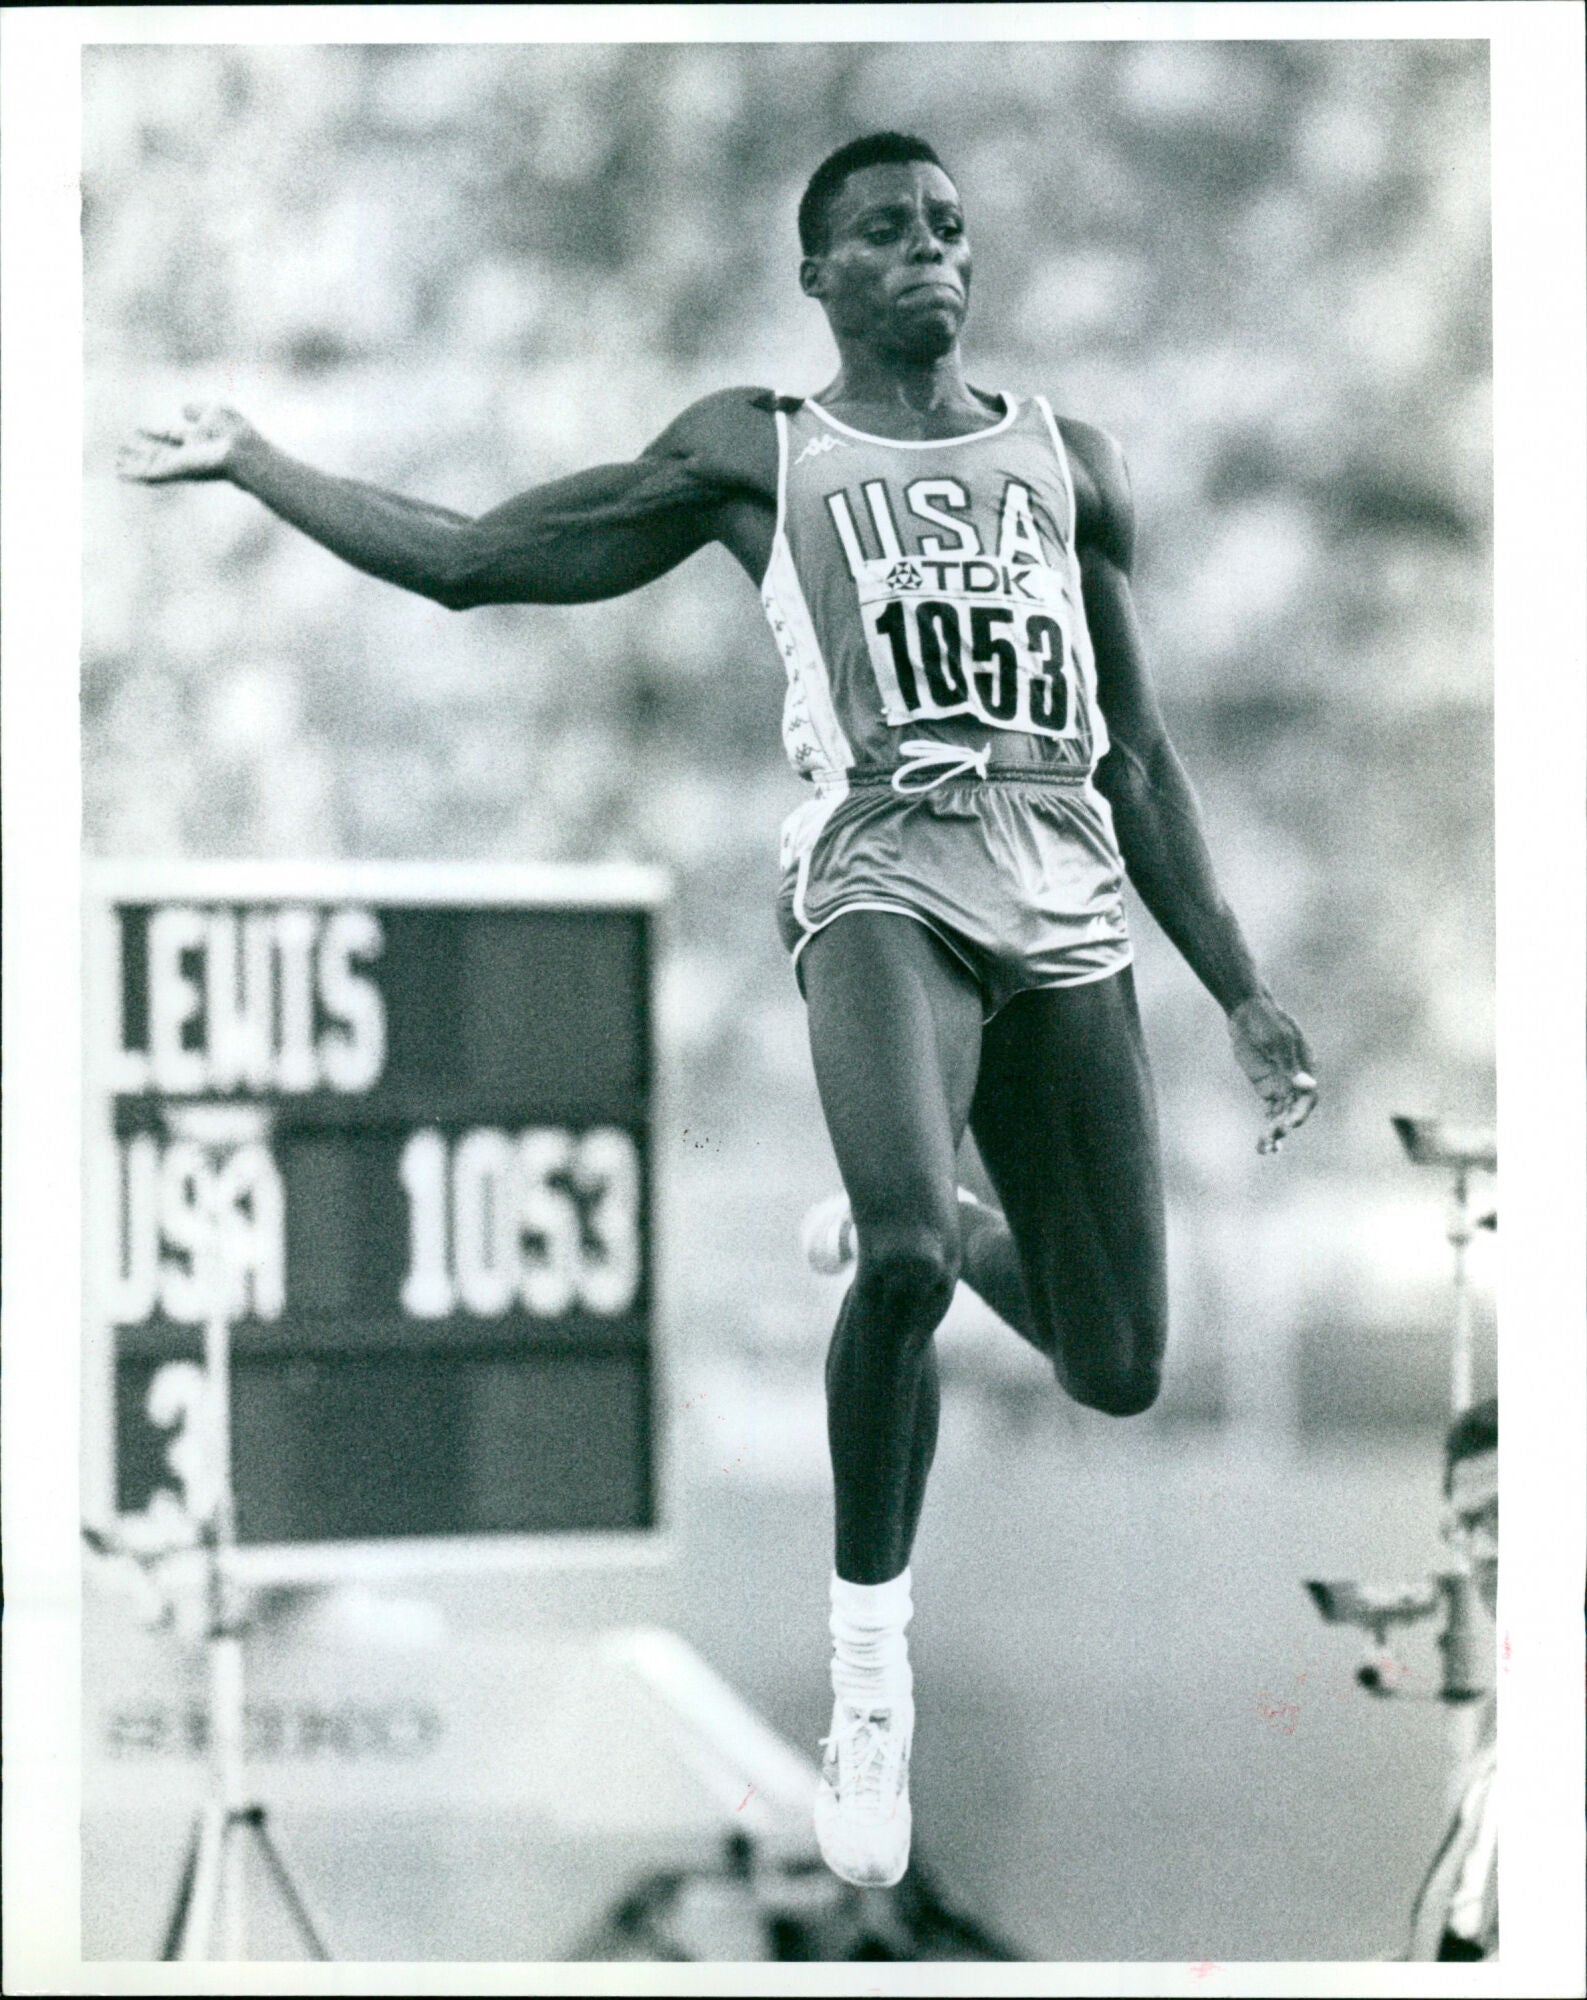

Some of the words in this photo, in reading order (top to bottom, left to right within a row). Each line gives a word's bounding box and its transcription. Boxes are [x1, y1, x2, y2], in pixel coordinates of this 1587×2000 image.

[825, 477, 1048, 574] USA
[921, 560, 1035, 600] TDK
[876, 600, 1068, 731] 1053
[92, 906, 387, 1094] LEWIS
[92, 1133, 286, 1324] USA
[402, 1129, 641, 1318] 1053
